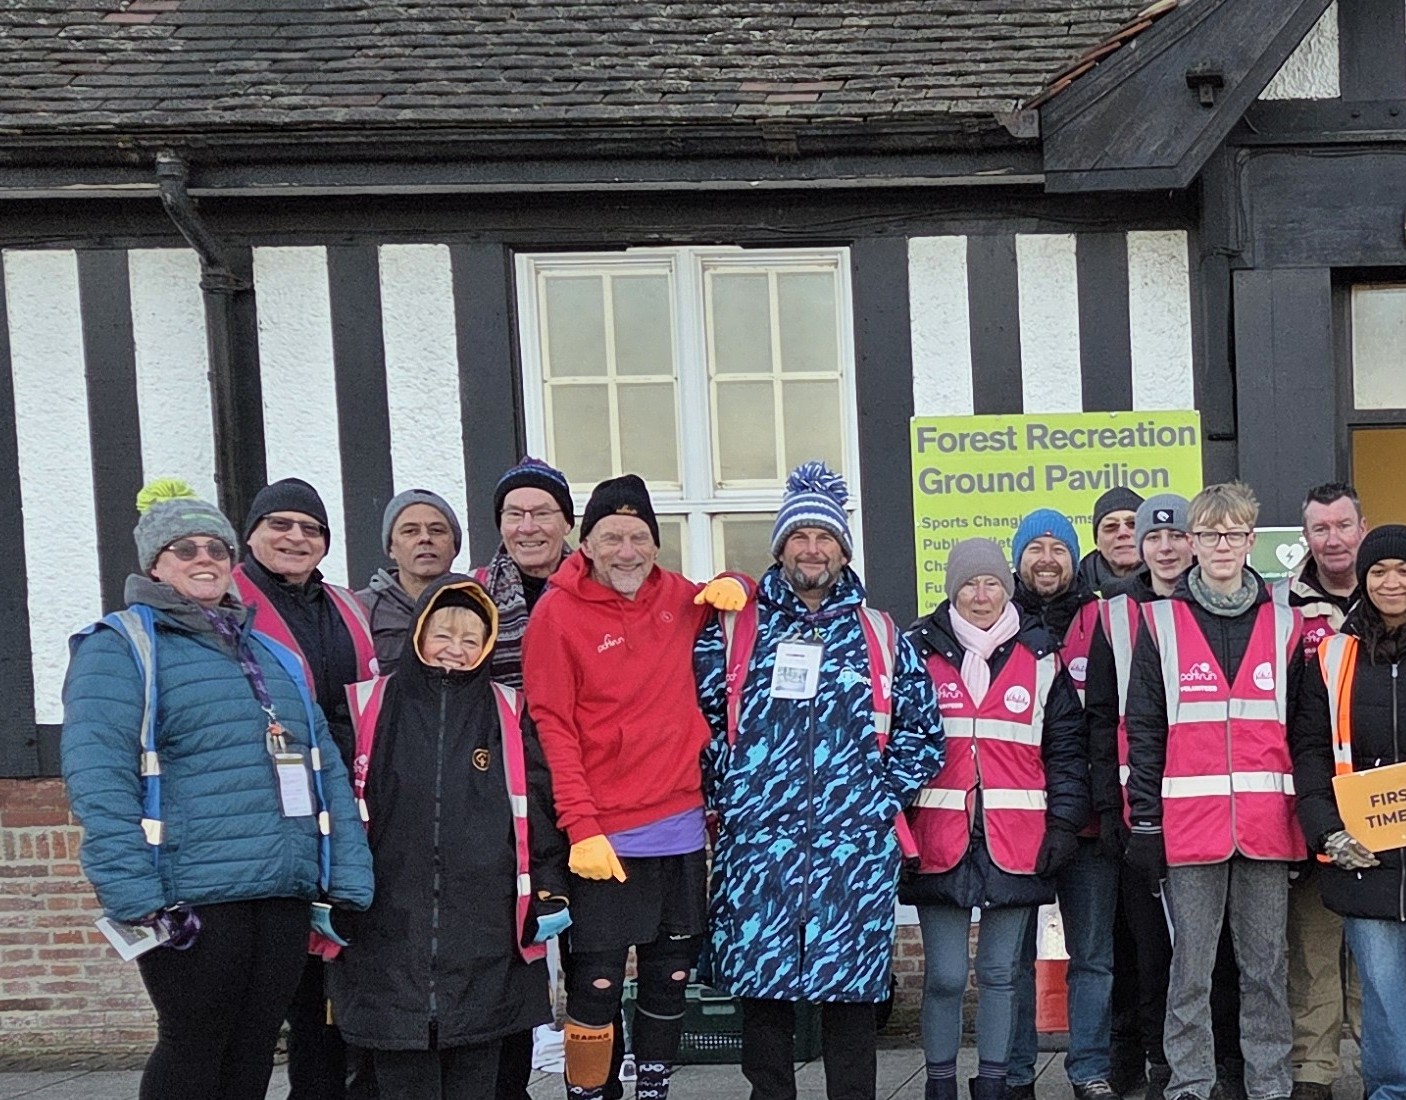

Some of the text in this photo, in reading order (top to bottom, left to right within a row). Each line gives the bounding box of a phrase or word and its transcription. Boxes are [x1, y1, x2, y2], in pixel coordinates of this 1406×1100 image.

[917, 421, 1197, 453] Forest Recreation
[918, 463, 1170, 495] Ground Pavilion
[921, 515, 1094, 531] Sports Changi oms
[923, 538, 959, 550] Publ
